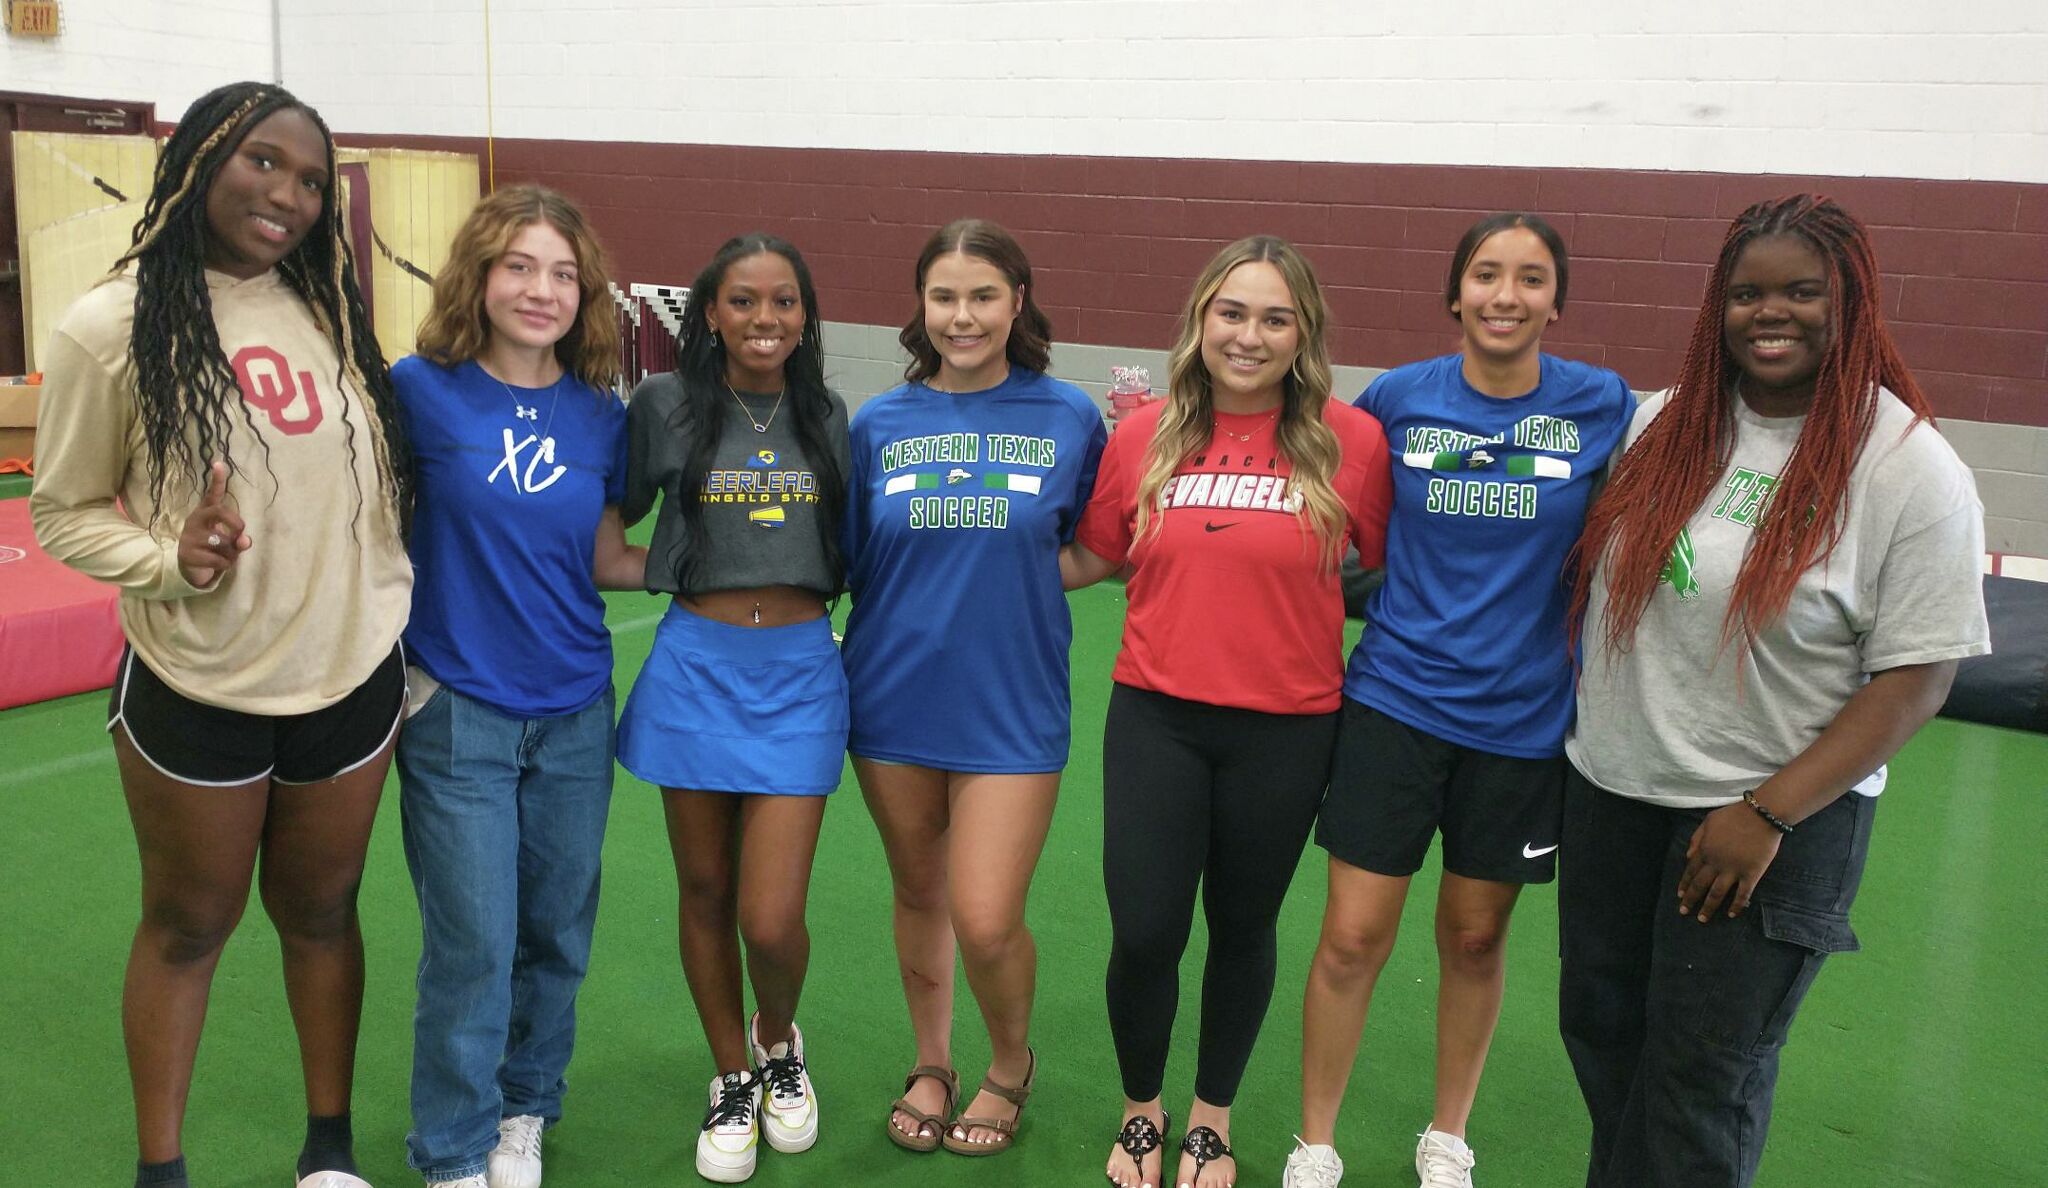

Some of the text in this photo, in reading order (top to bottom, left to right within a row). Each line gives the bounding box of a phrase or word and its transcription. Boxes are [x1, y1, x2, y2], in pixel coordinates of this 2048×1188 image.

[231, 345, 324, 436] OU
[487, 428, 567, 495] XC
[882, 433, 1056, 473] WESTERN TEXAS
[910, 496, 1009, 529] SOCCER
[1427, 478, 1537, 520] SOCCER
